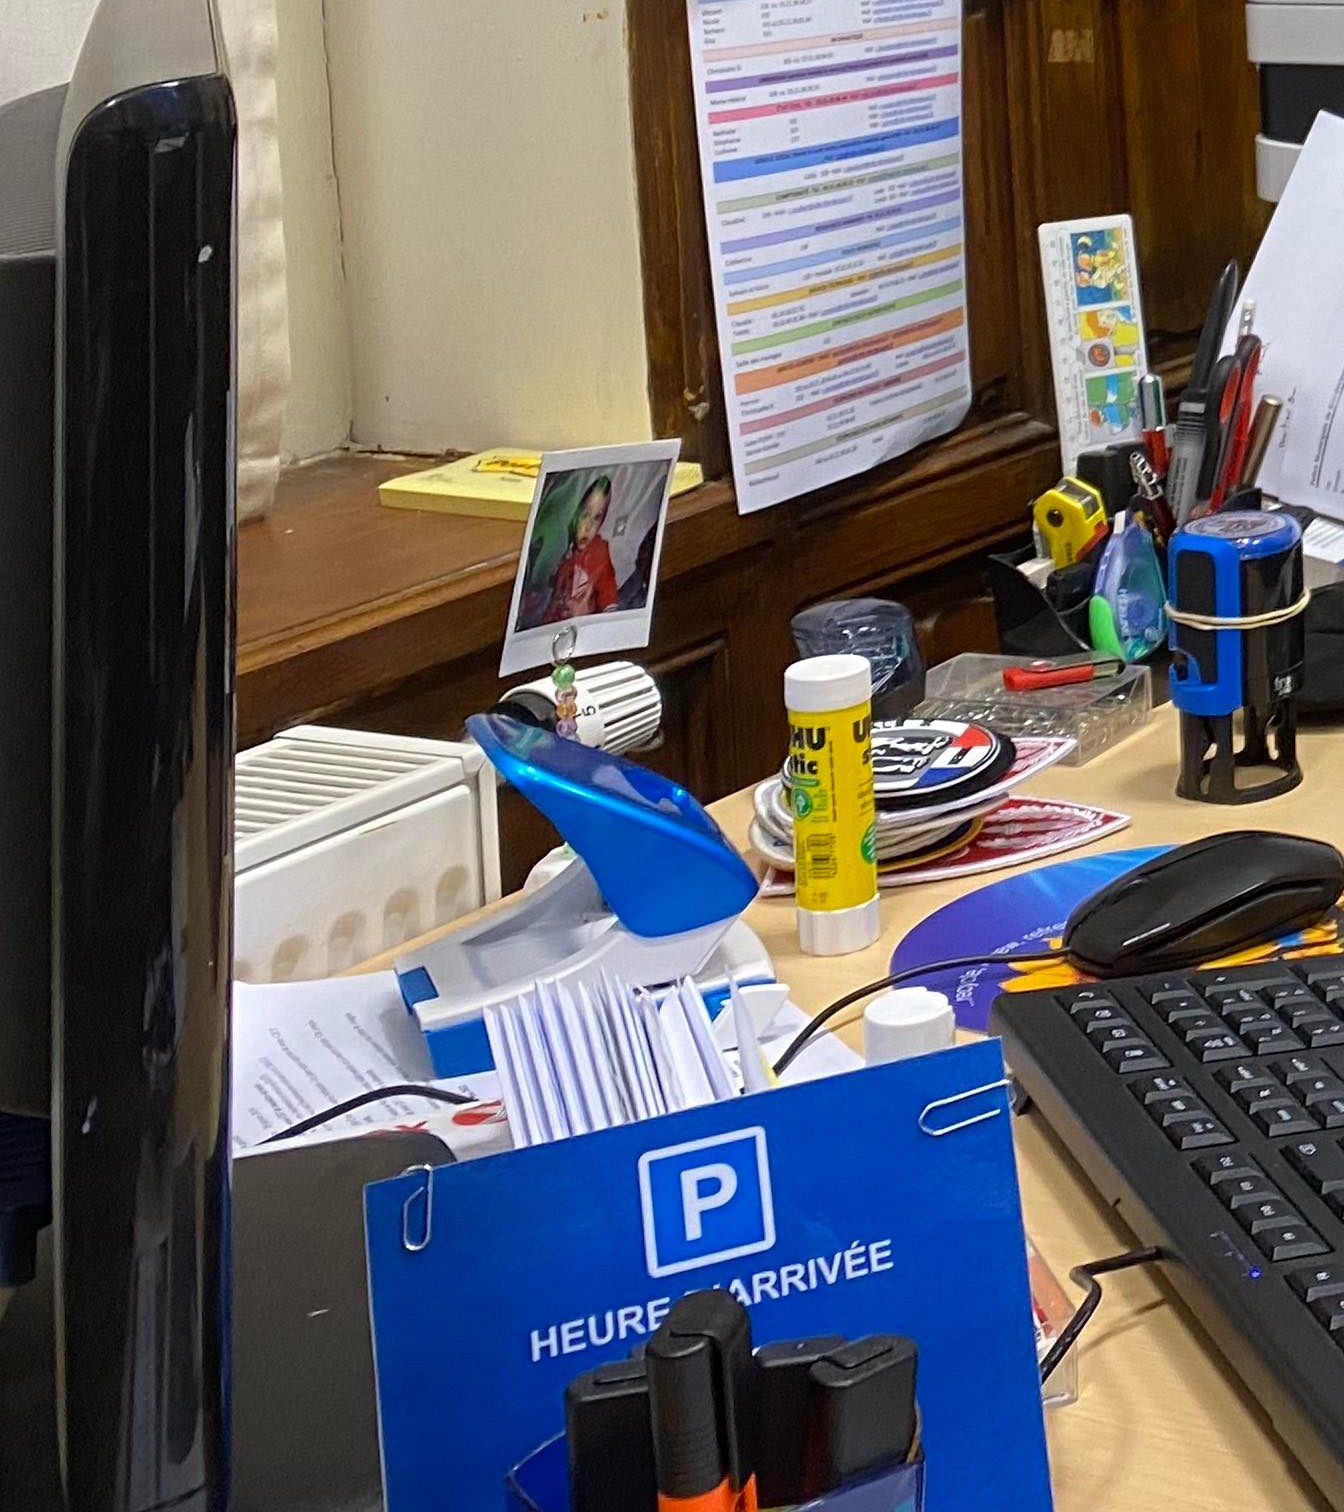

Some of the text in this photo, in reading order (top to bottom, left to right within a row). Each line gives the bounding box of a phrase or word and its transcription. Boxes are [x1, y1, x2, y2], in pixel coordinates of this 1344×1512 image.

[790, 725, 826, 751] HU
[790, 753, 819, 776] tic
[679, 1162, 739, 1242] P
[529, 1297, 672, 1363] HEURE
